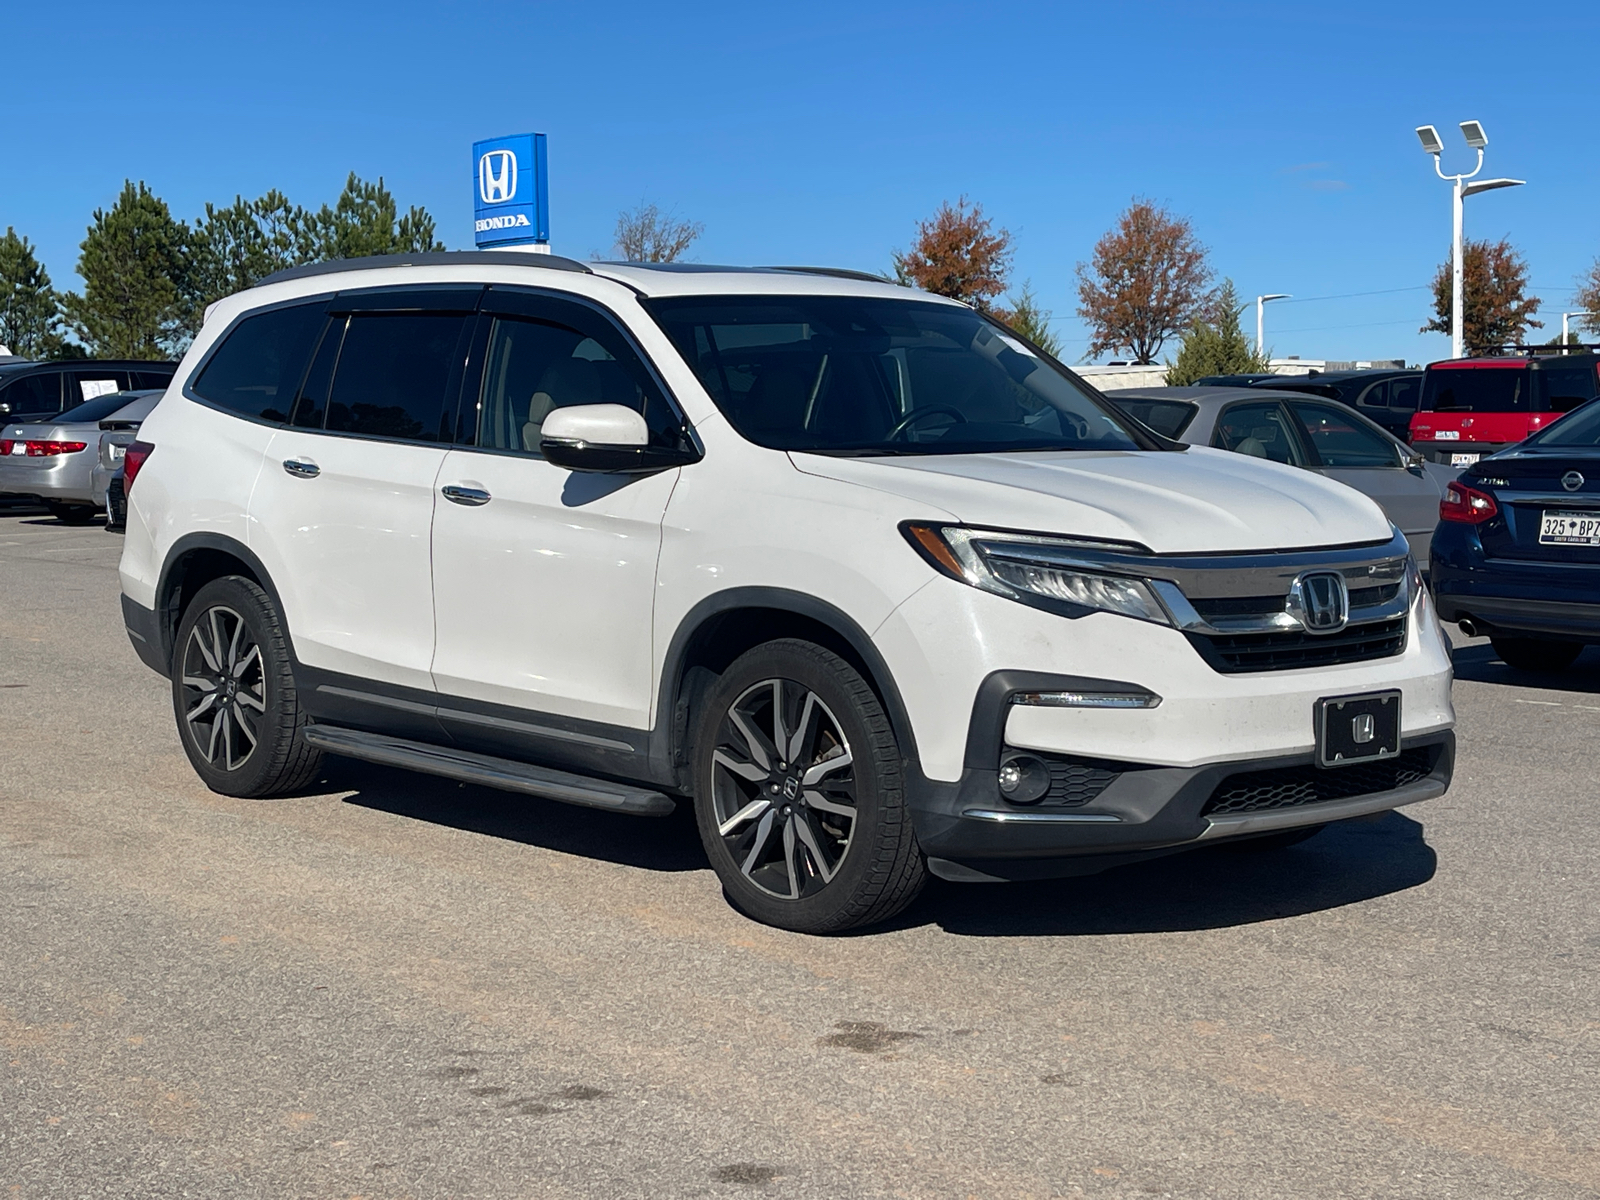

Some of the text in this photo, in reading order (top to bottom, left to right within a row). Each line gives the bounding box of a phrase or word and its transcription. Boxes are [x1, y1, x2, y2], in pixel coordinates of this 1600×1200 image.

[475, 214, 531, 232] HONDA
[1544, 518, 1600, 537] 325 BPZ
